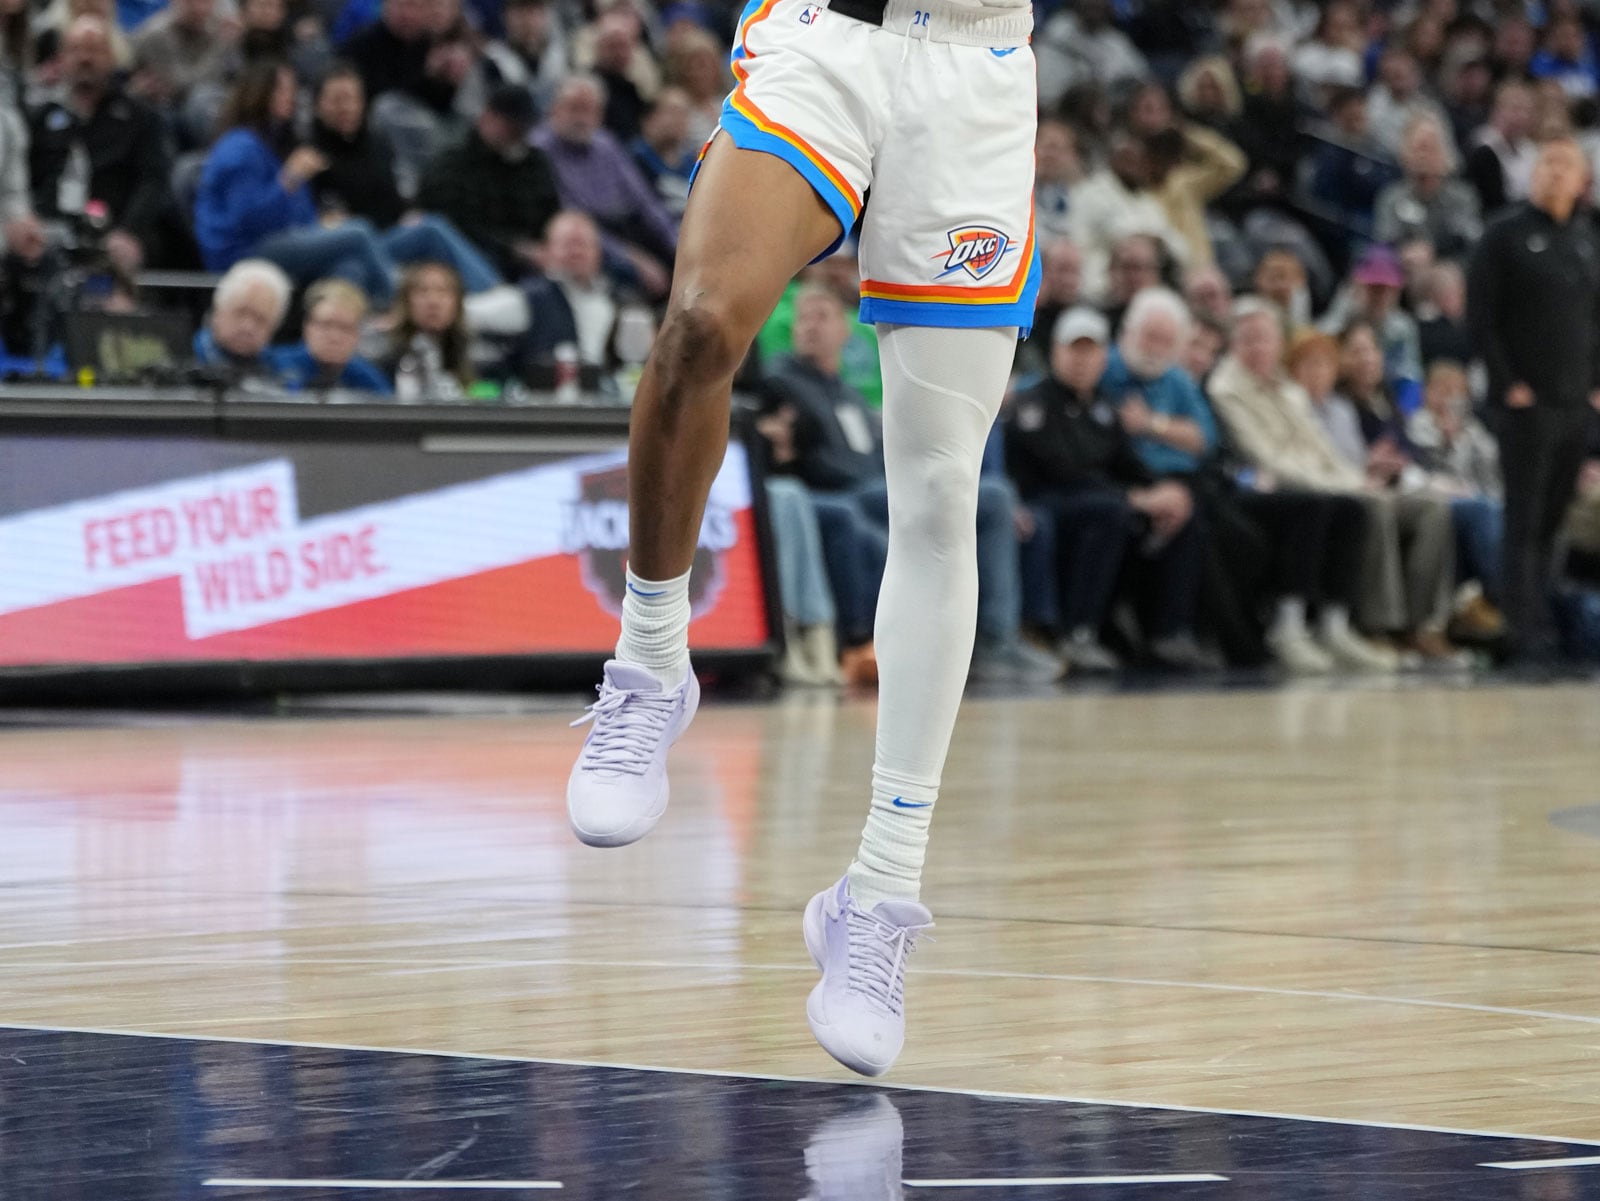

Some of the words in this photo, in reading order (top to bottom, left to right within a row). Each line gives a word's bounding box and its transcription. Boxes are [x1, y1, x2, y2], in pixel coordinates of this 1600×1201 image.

[946, 238, 996, 268] OKC
[83, 506, 177, 571] FEED
[180, 484, 281, 546] YOUR
[195, 548, 292, 613] WILD
